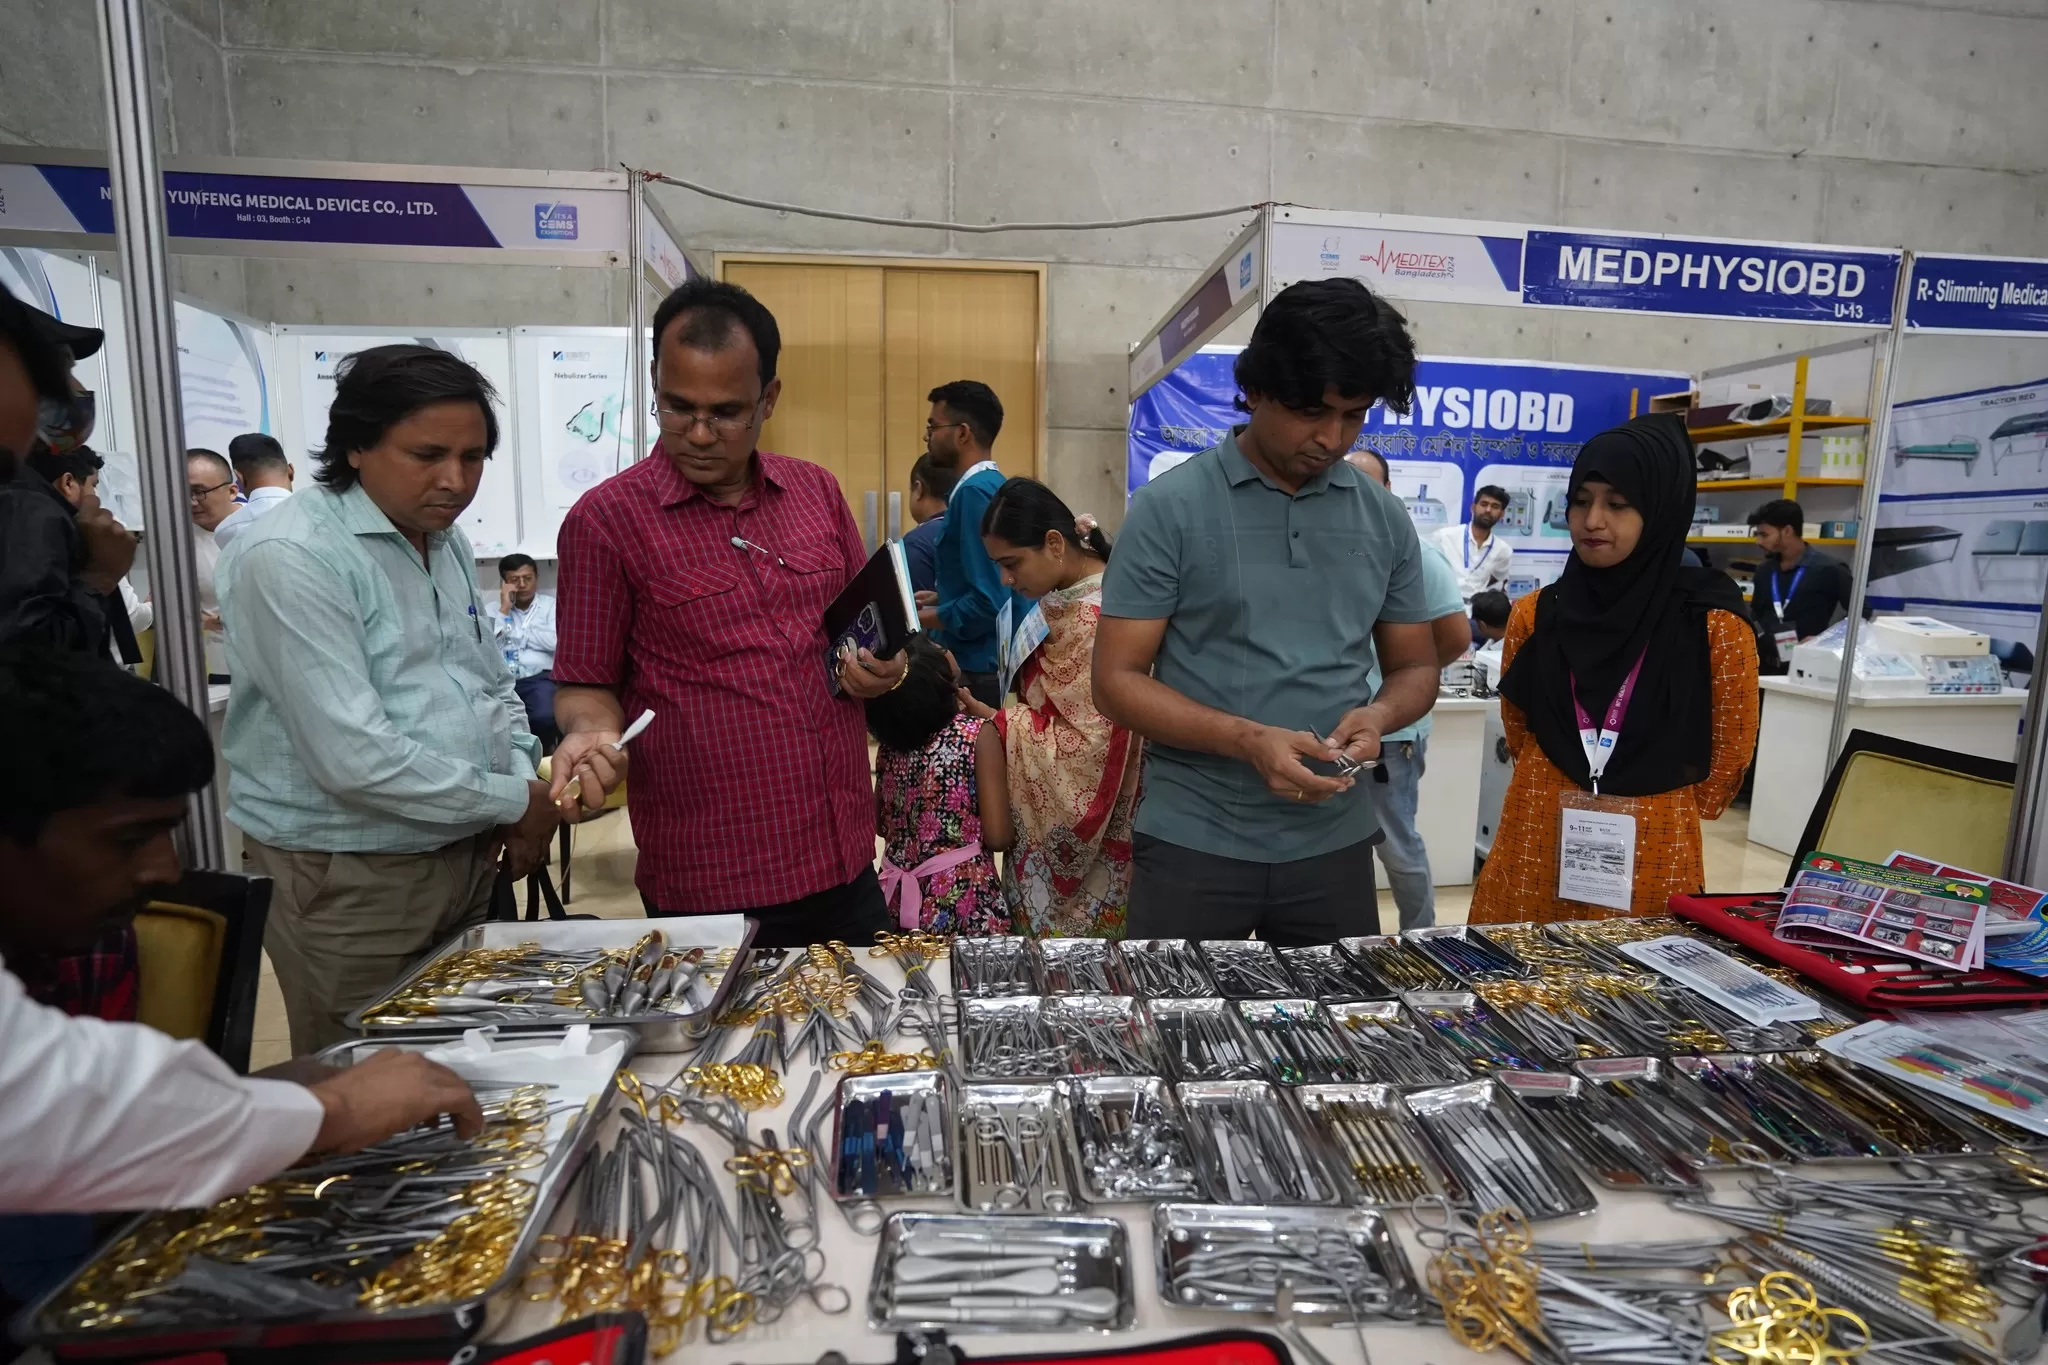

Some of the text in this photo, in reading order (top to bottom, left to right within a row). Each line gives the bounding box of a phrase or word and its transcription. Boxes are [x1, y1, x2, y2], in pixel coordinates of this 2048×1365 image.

[168, 190, 438, 216] YUNFENG MEDICAL DEVICE CO., LTD.
[237, 213, 251, 222] Hall
[269, 215, 291, 224] Booth
[296, 216, 311, 225] C-14
[1394, 269, 1447, 279] Bangladesh
[1558, 245, 1866, 298] MEDPHYSIOBD
[1935, 279, 1999, 310] Slimming
[1834, 303, 1864, 319] U-13
[1980, 396, 2017, 407] TRACTION
